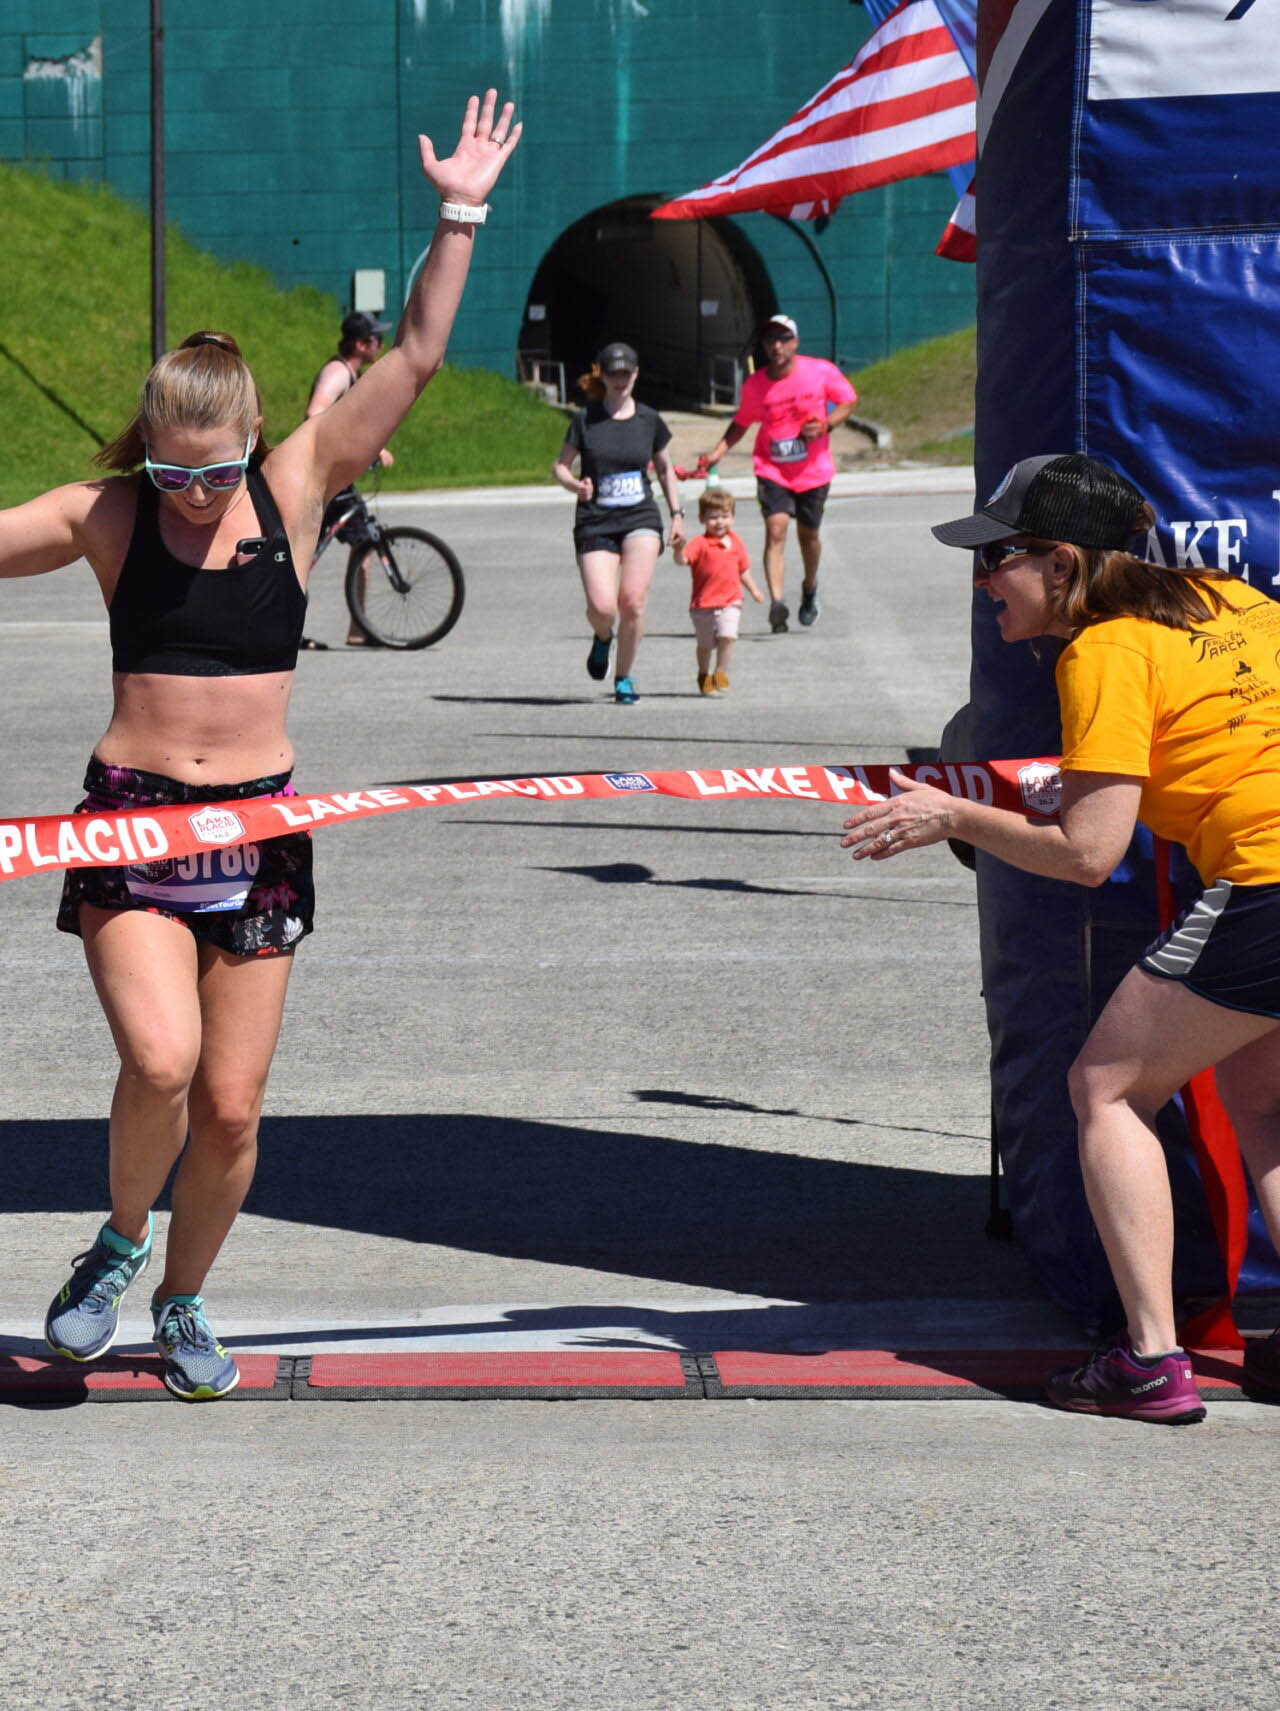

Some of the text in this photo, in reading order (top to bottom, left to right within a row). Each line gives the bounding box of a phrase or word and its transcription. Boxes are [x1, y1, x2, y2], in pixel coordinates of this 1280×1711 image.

[1144, 519, 1250, 584] AKE
[1210, 638, 1247, 661] ARCH
[686, 766, 820, 799] LAKE
[1026, 775, 1058, 785] LAKE
[272, 776, 585, 827] LAKE PLACID
